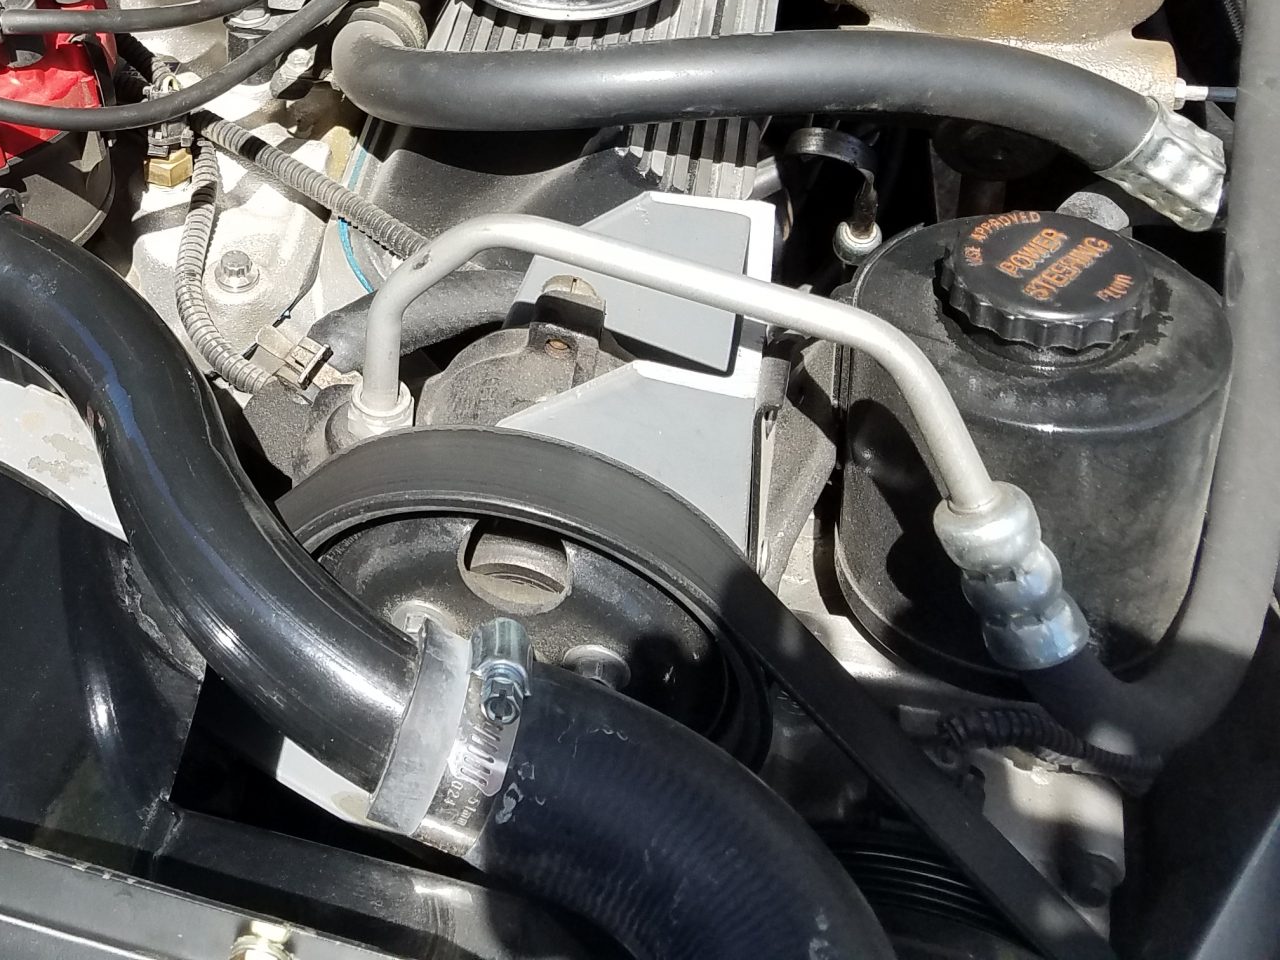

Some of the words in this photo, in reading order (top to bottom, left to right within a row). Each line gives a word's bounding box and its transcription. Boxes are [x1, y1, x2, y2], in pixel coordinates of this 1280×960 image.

[970, 210, 1042, 243] APPROVED
[996, 227, 1068, 279] POWER
[1022, 235, 1113, 302] STEERING
